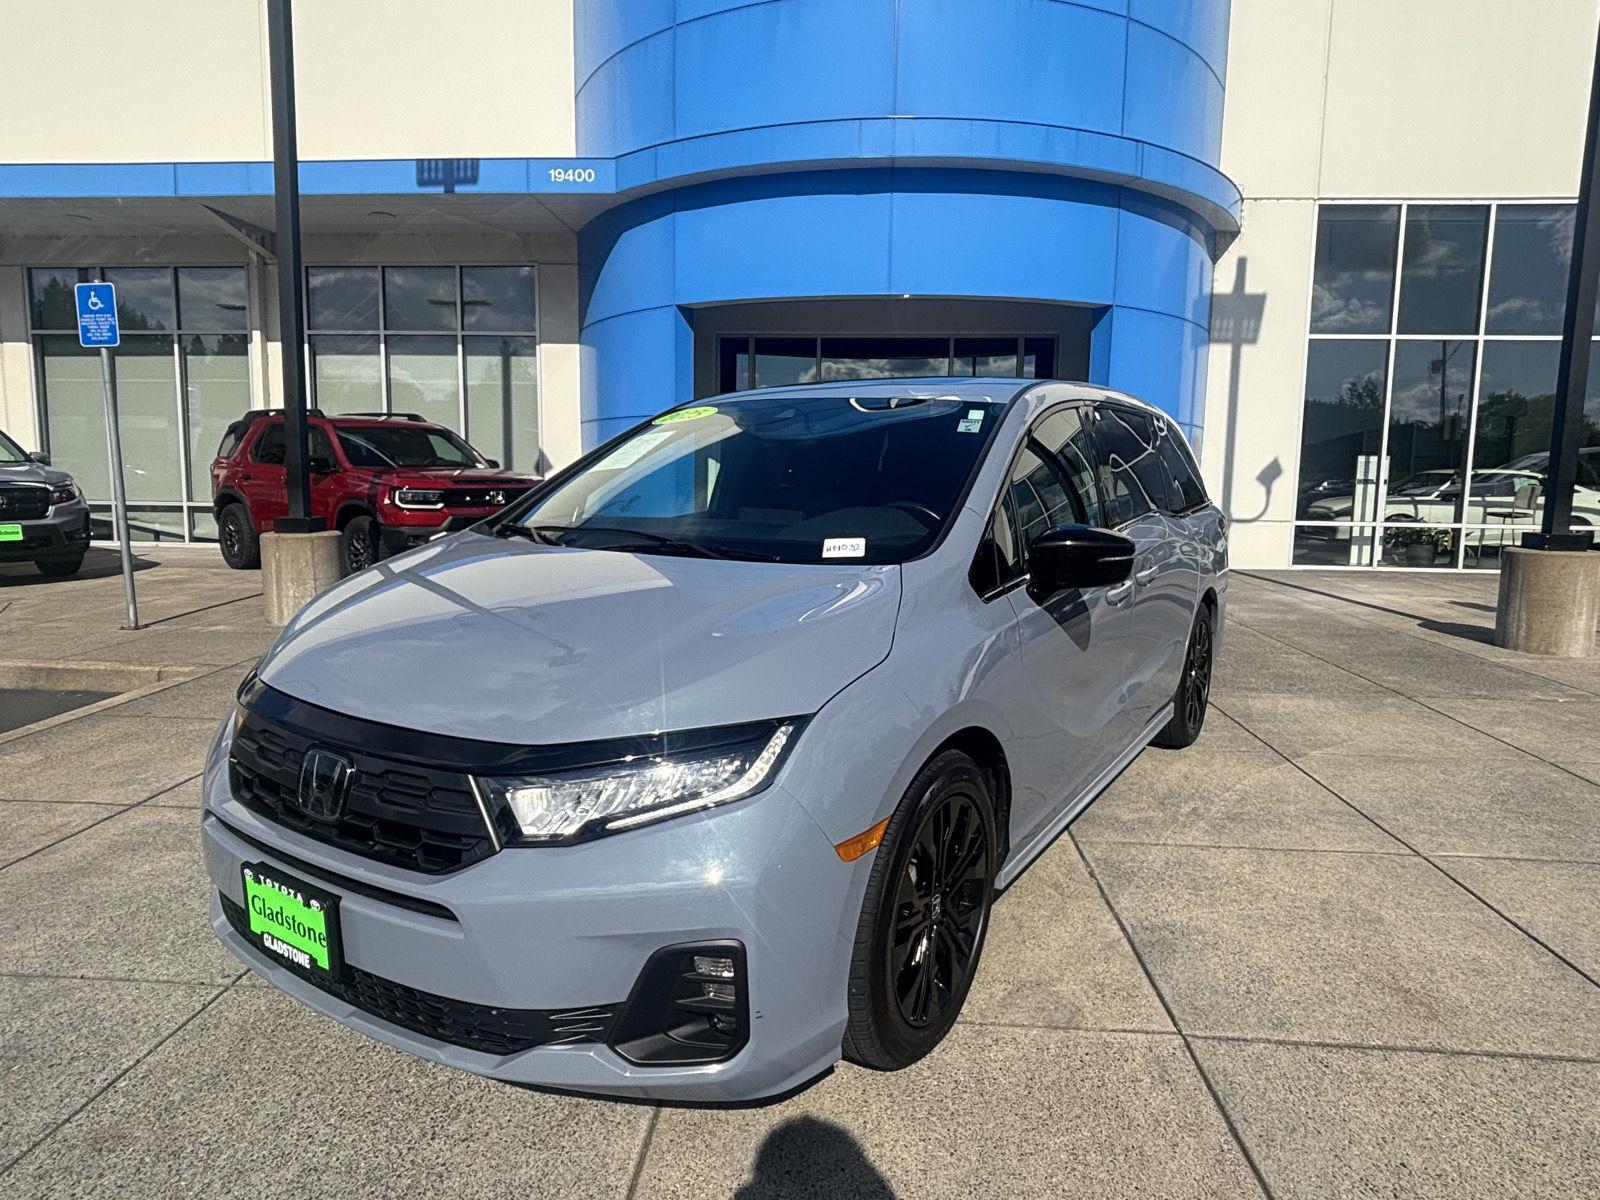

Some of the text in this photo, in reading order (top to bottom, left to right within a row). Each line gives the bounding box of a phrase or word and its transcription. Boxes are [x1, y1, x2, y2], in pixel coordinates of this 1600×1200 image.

[548, 168, 595, 182] 19400
[259, 875, 304, 903] TOYOTA
[251, 894, 328, 948] Gladstone
[263, 933, 310, 969] GLADSTONE
